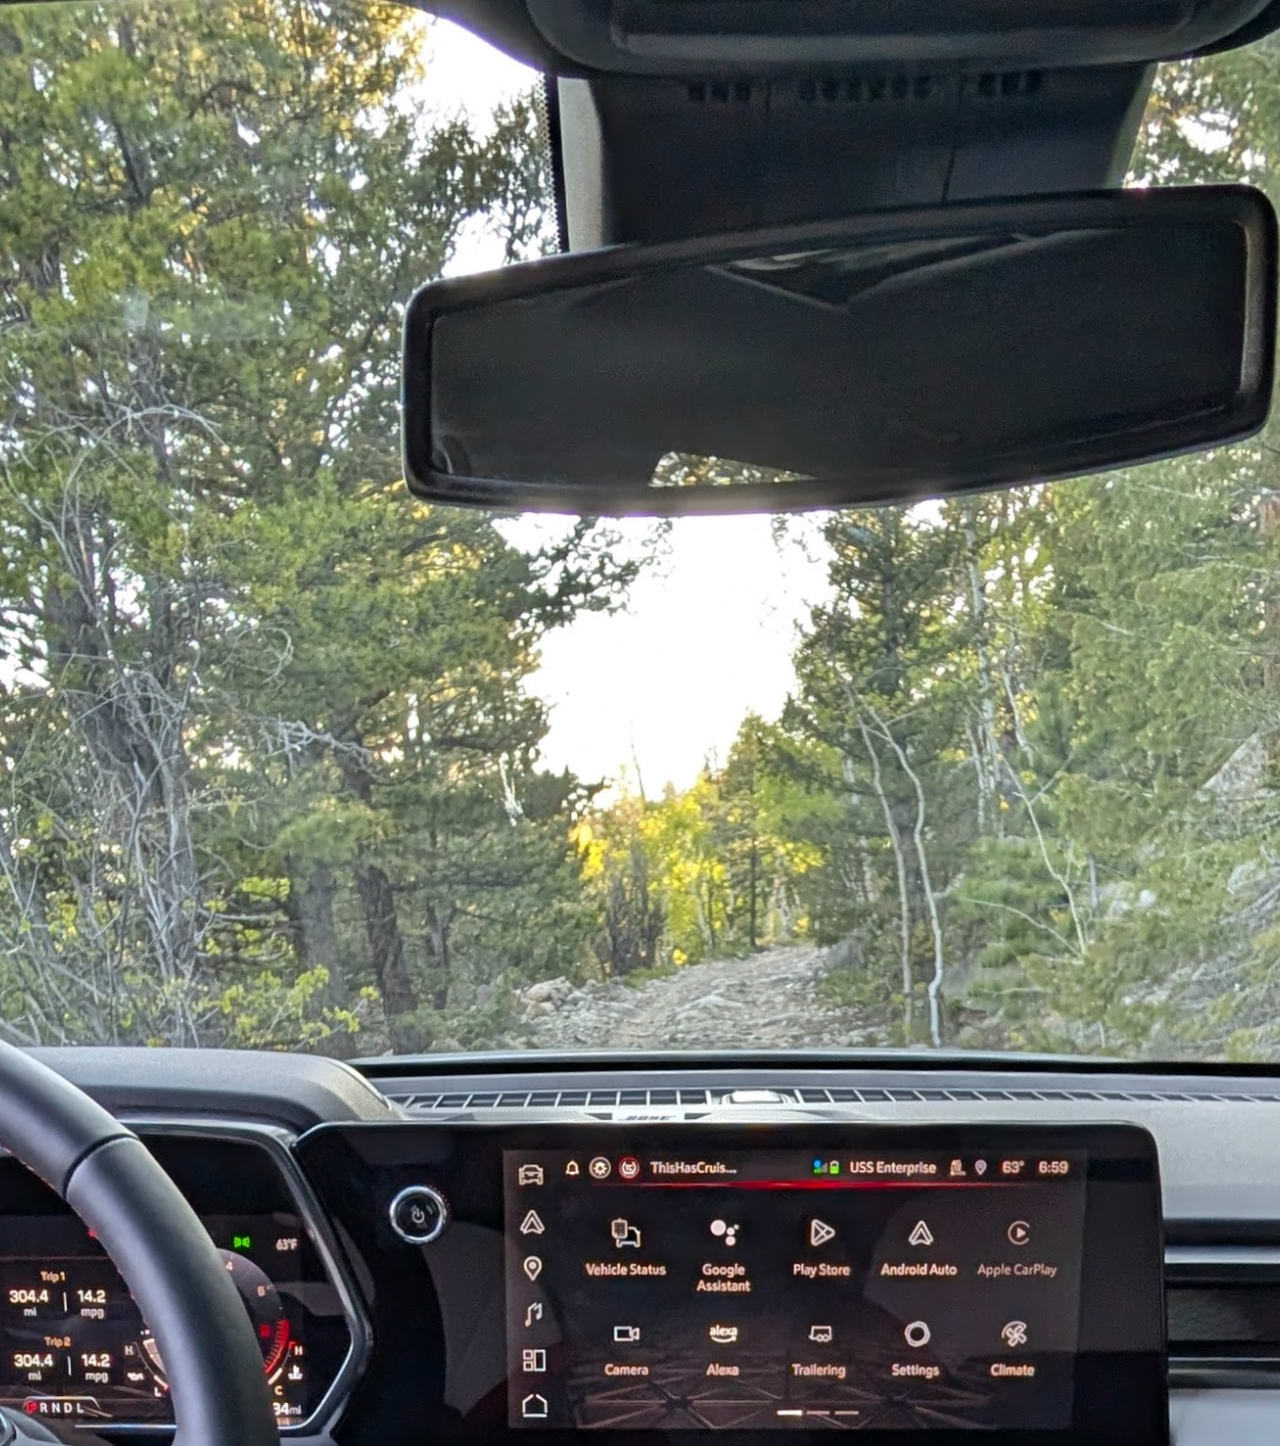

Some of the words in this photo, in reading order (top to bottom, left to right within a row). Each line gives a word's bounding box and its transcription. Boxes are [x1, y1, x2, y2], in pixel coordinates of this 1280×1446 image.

[650, 1161, 737, 1174] ThisHasCruis...
[850, 1161, 873, 1174] USS
[876, 1160, 937, 1176] Enterprise
[1002, 1160, 1025, 1174] 63°
[1038, 1160, 1069, 1174] 6:59
[225, 1261, 233, 1270] 4
[585, 1263, 628, 1276] Vehicle
[629, 1263, 667, 1276] Status
[702, 1263, 745, 1278] Google
[793, 1264, 817, 1278] Play
[819, 1263, 851, 1276] Store
[881, 1263, 927, 1276] Android
[930, 1263, 958, 1276] Auto
[977, 1264, 1011, 1278] Apple
[1014, 1263, 1058, 1278] CarPlay
[40, 1271, 59, 1283] Trip
[696, 1280, 751, 1292] Assistant
[9, 1289, 49, 1303] 304.4
[77, 1289, 106, 1303] 14.2
[24, 1308, 37, 1317] mi
[80, 1308, 105, 1319] mpg
[709, 1325, 738, 1336] alexa
[44, 1337, 62, 1348] Trip
[64, 1337, 71, 1347] 2
[124, 1346, 133, 1355] H
[294, 1346, 303, 1355] H
[14, 1354, 53, 1367] 304.4
[81, 1354, 110, 1367] 14.2
[28, 1371, 41, 1381] mi
[604, 1363, 649, 1376] Camera
[706, 1363, 740, 1376] Alexa
[792, 1363, 846, 1378] Trailering
[892, 1363, 939, 1378] Settings
[990, 1363, 1035, 1376] Climate
[85, 1372, 109, 1383] mpg
[154, 1388, 161, 1397] L
[274, 1385, 283, 1395] C
[40, 1402, 48, 1413] R
[51, 1402, 60, 1413] N
[64, 1402, 72, 1413] D
[77, 1402, 84, 1413] L
